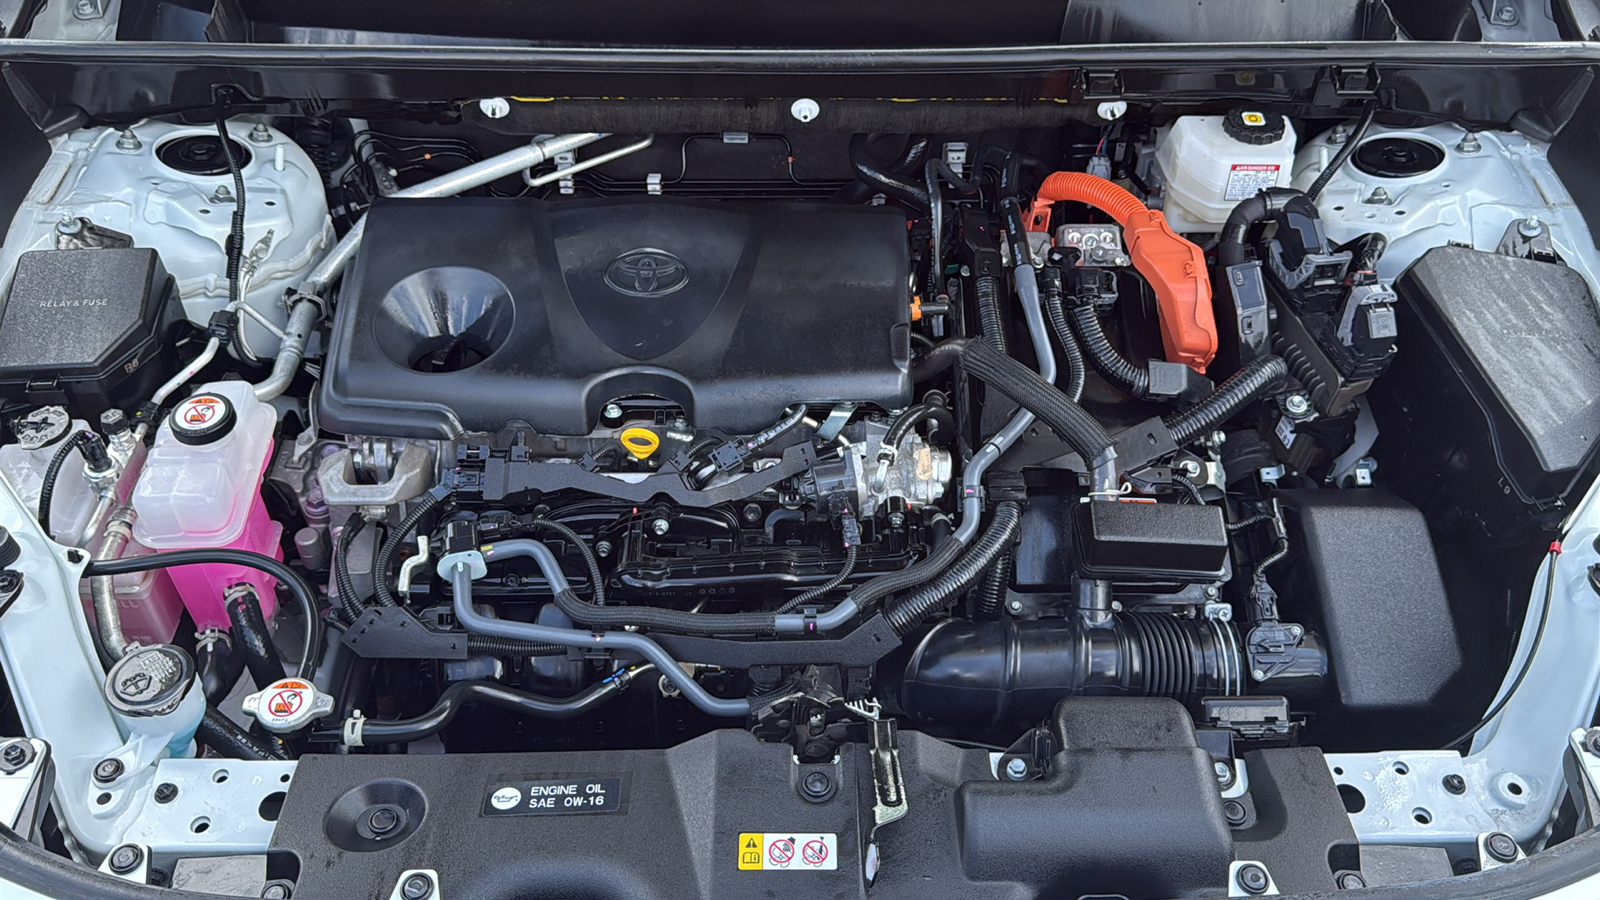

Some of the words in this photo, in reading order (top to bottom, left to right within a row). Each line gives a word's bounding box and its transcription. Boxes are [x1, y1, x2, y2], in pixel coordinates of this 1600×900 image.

[39, 299, 72, 308] RELAY
[82, 298, 109, 306] FUSE
[530, 784, 578, 796] ENGINE
[585, 783, 606, 794] OIL
[528, 797, 556, 808] SAE
